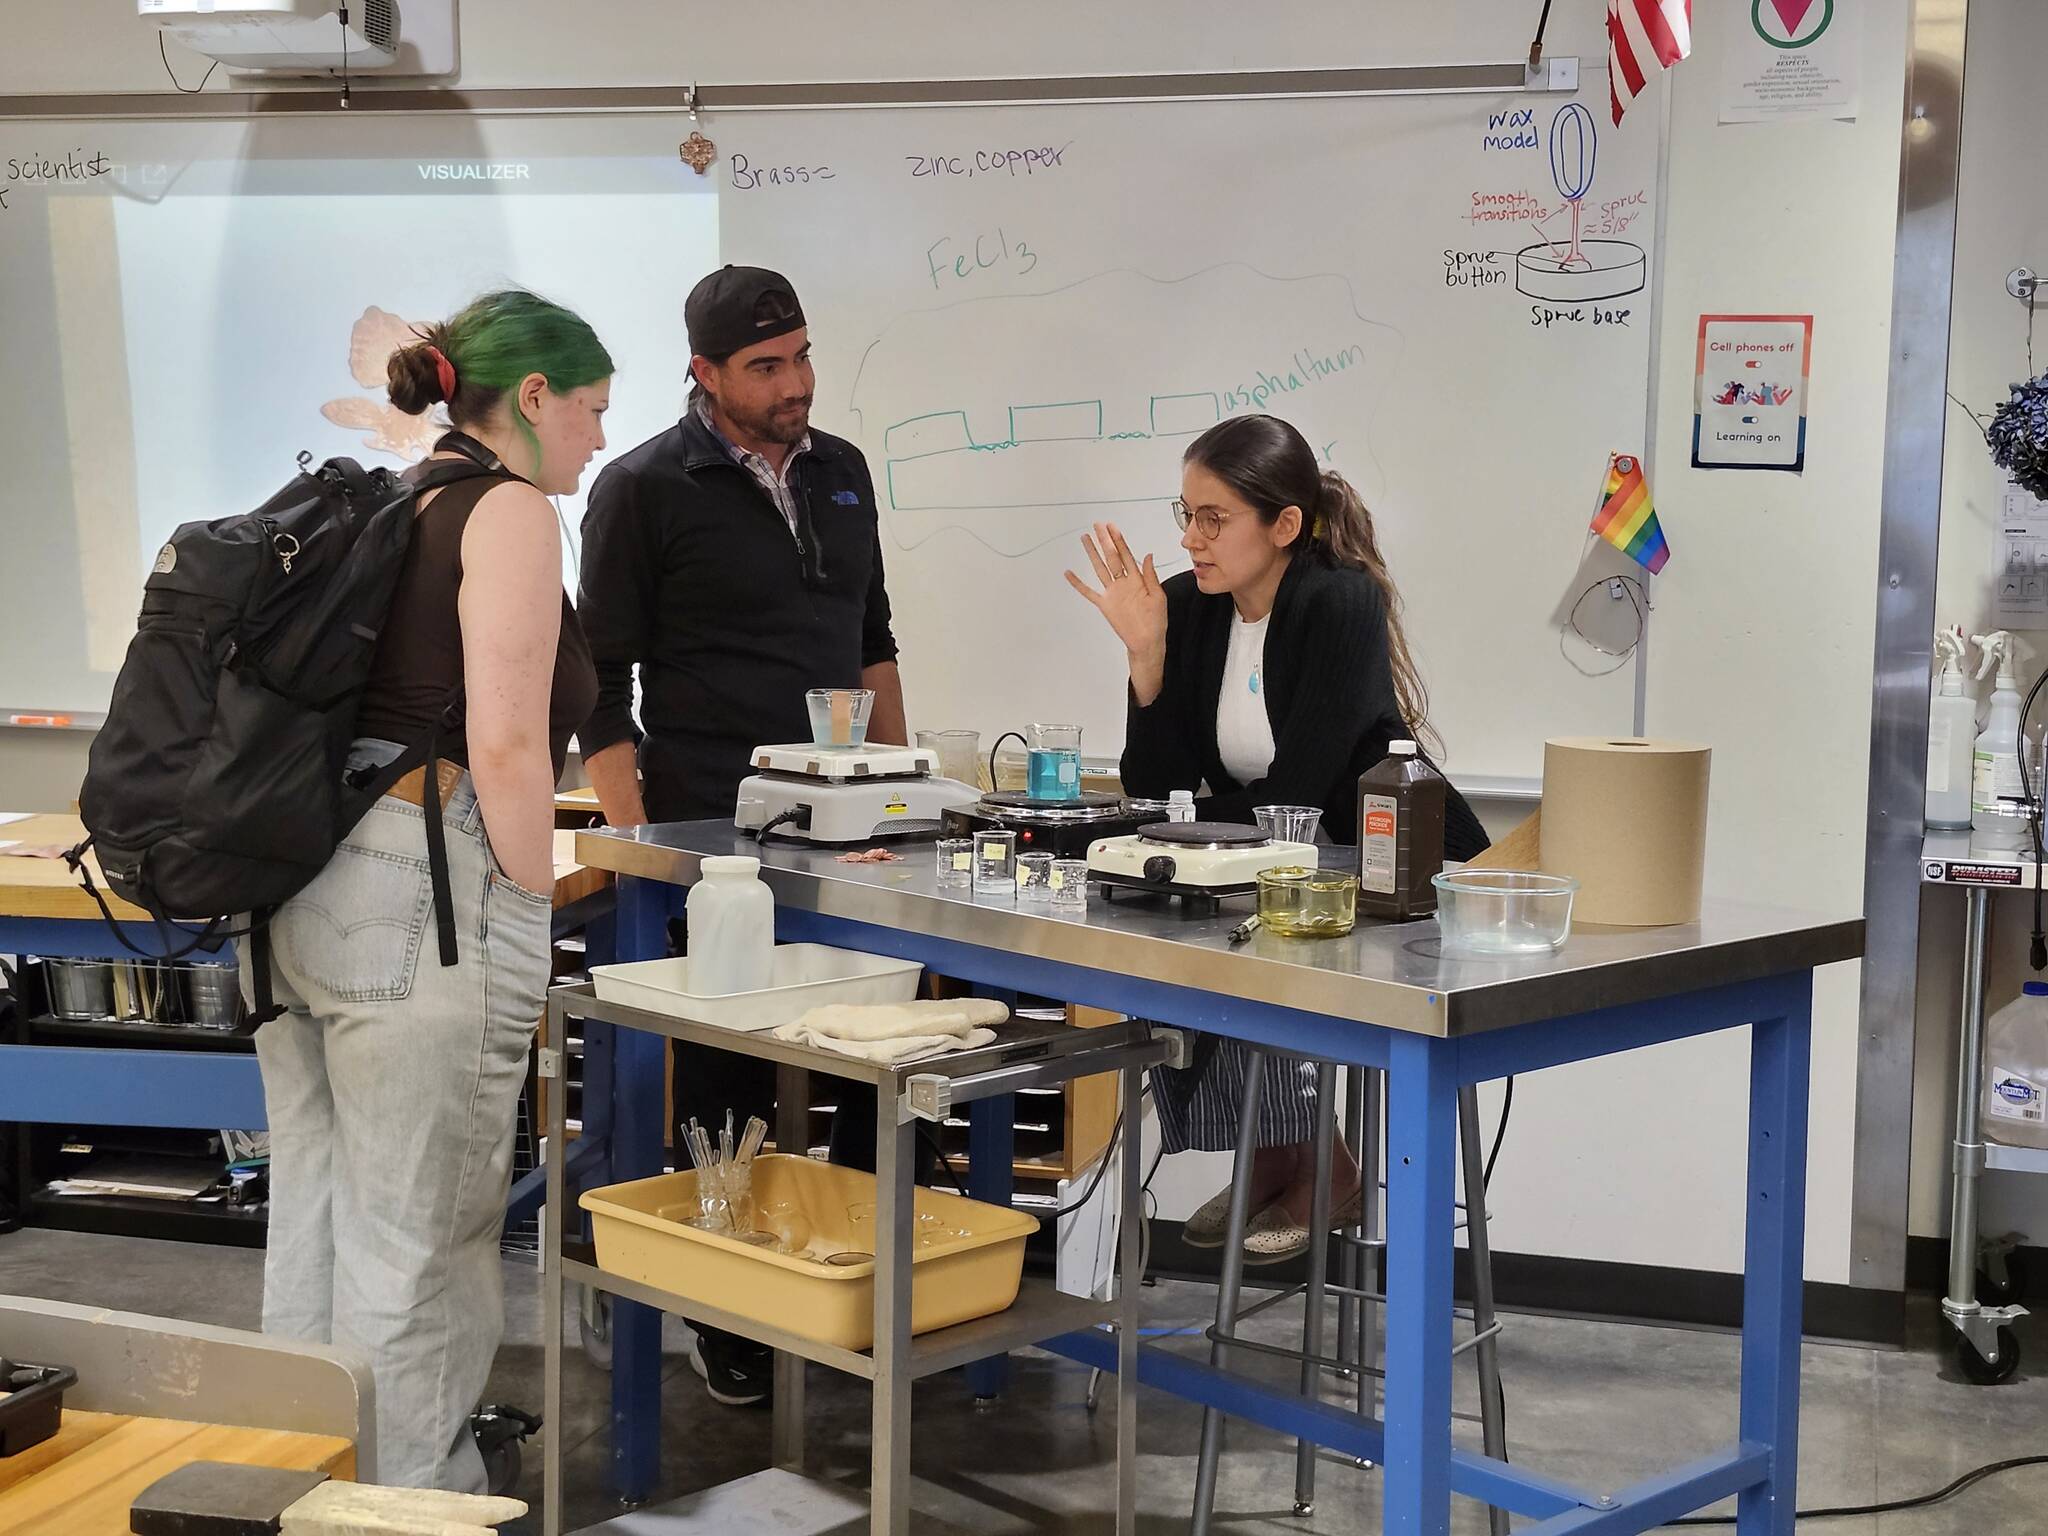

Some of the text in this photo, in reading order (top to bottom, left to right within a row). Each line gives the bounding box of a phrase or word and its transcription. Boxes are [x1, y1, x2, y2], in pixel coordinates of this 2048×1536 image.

[8, 147, 112, 180] scientist
[418, 164, 531, 180] VISUALIZER
[1464, 204, 1548, 226] transitions
[1446, 269, 1507, 288] button
[1593, 306, 1632, 328] base
[1710, 342, 1795, 354] Cell phones off
[1224, 343, 1366, 410] asphaltum
[1716, 432, 1781, 444] Learning on
[1927, 865, 1942, 877] NSF
